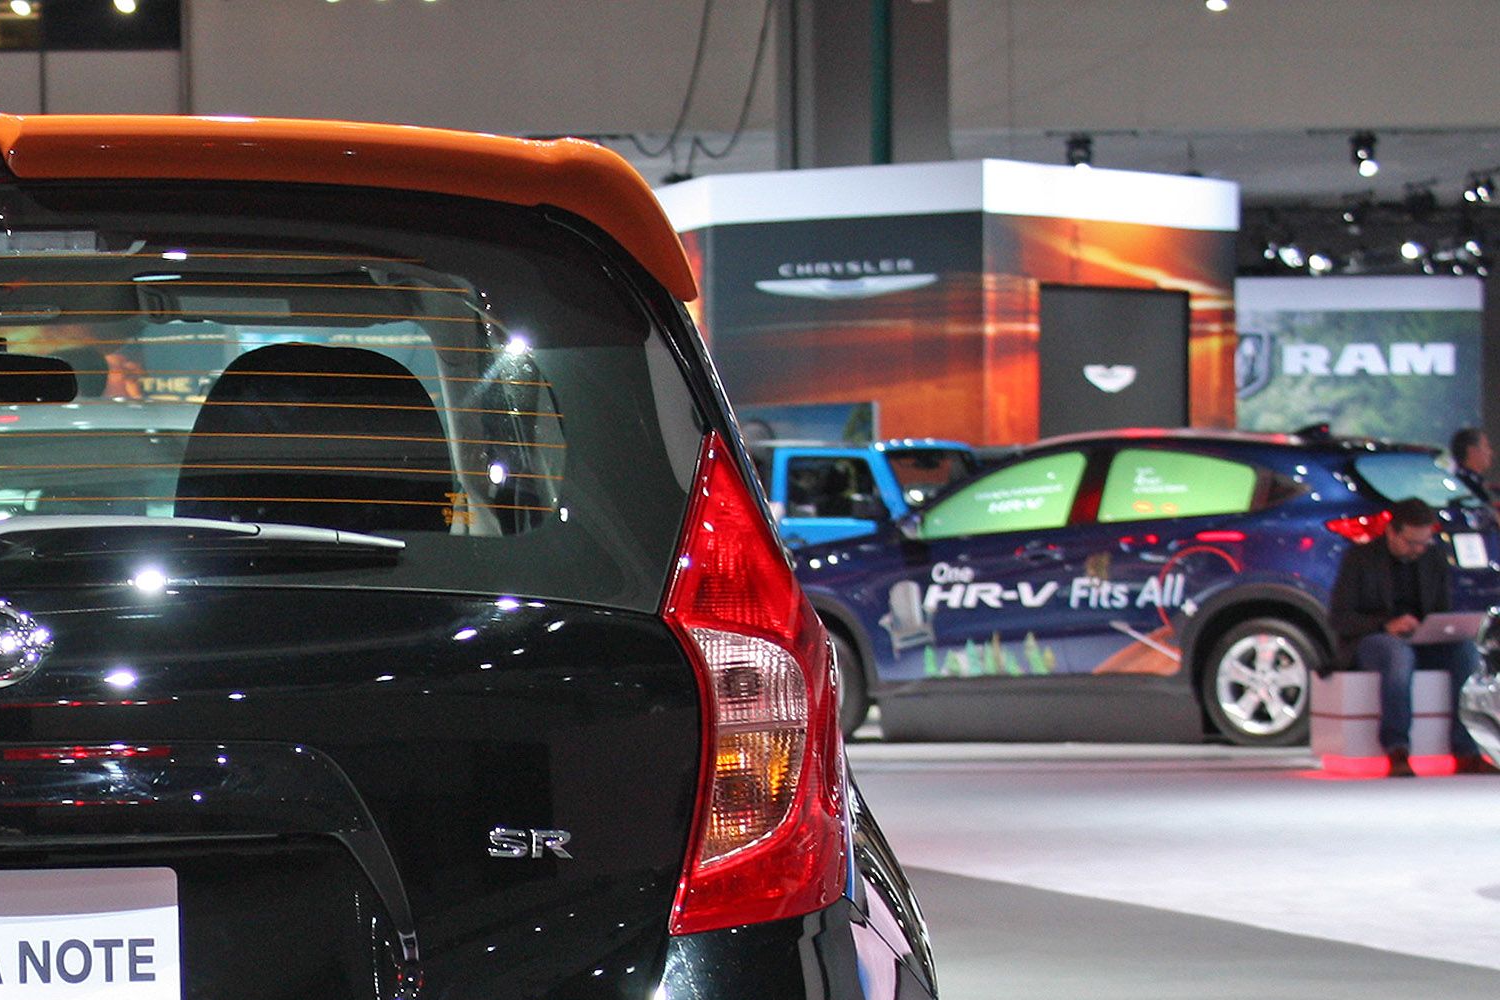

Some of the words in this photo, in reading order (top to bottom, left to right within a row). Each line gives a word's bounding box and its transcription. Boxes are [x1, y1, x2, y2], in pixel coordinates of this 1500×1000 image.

[777, 257, 915, 278] CHRYSLER
[1282, 341, 1456, 376] RAM
[931, 561, 975, 584] One
[923, 581, 1059, 610] HR-V
[1069, 576, 1129, 609] Fits
[487, 827, 574, 859] SR
[17, 937, 157, 985] NOTE
